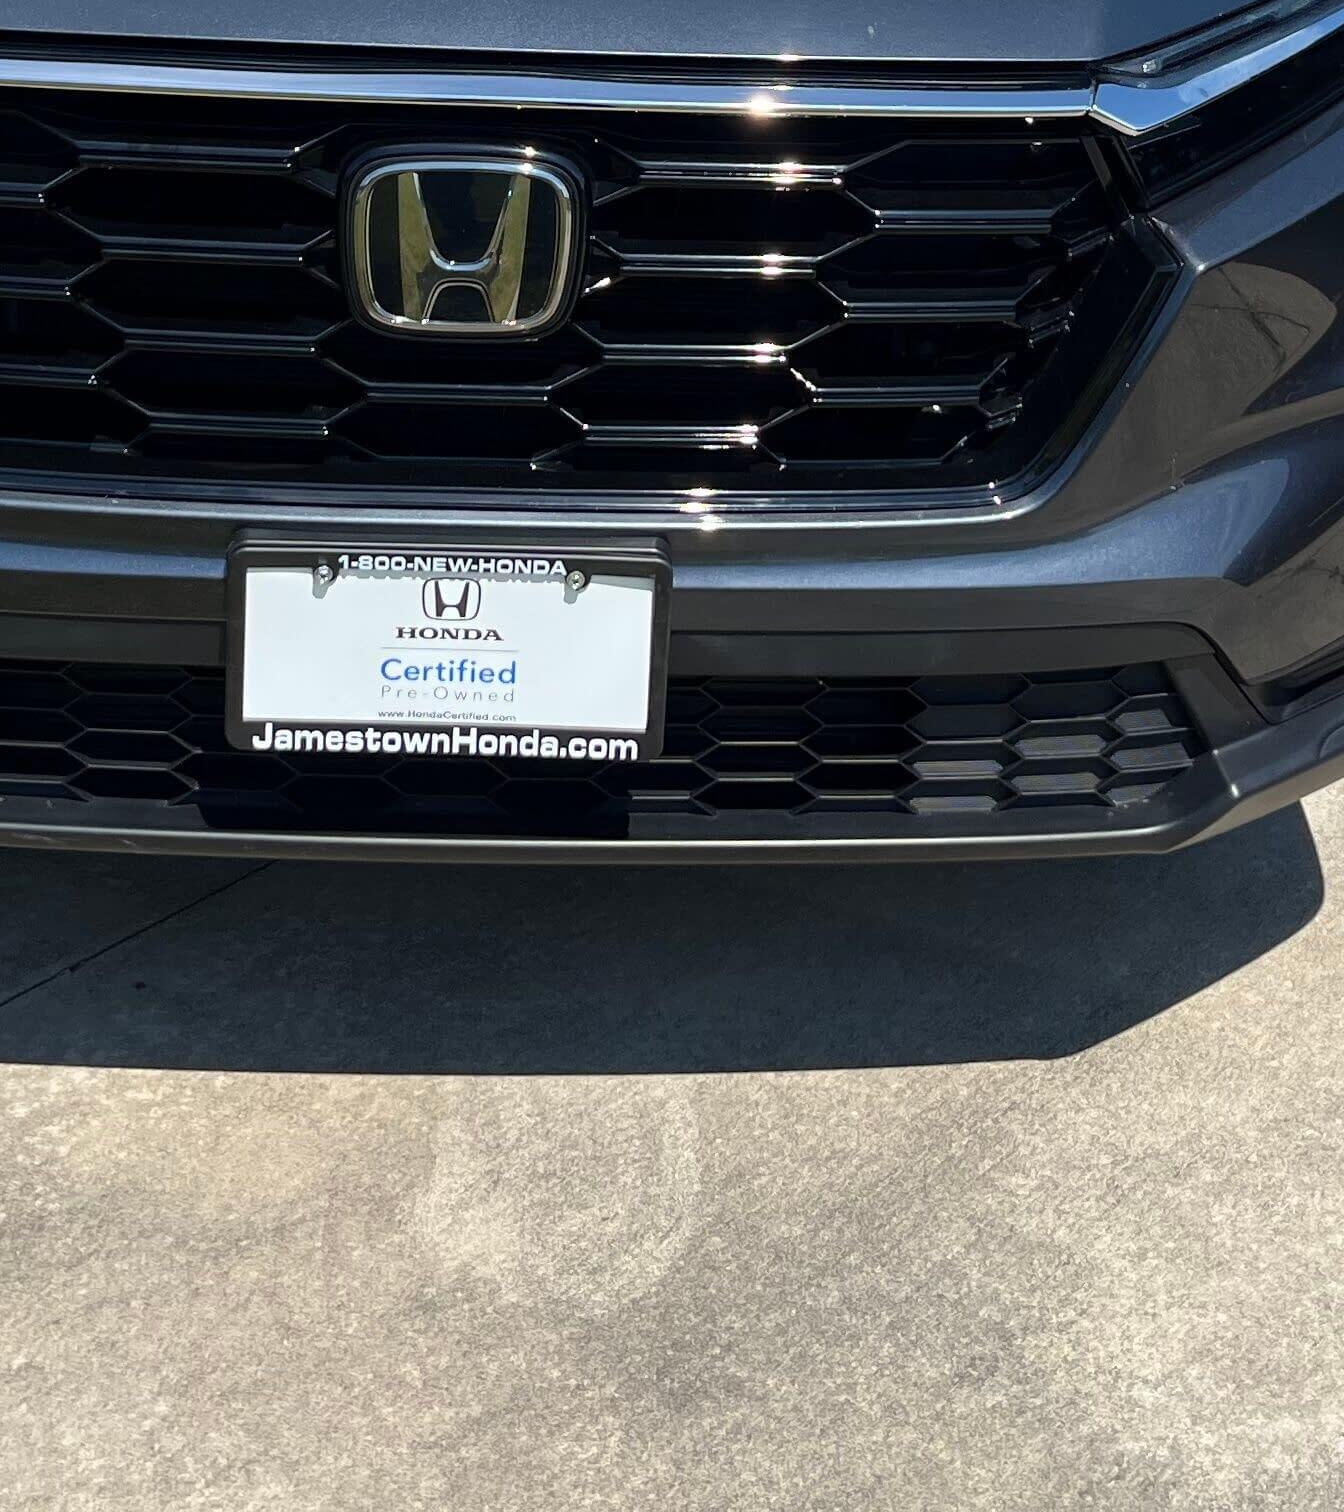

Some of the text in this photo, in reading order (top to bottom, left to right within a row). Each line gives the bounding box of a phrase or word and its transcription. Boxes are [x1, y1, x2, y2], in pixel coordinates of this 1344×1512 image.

[337, 554, 567, 576] 1-800-NEW-HONDA
[394, 626, 505, 642] HONDA
[380, 658, 518, 685] Certified
[380, 685, 515, 703] Pre-Owned
[378, 710, 517, 722] www.HondaCertified.com
[252, 722, 639, 760] JamestownHonda.com
